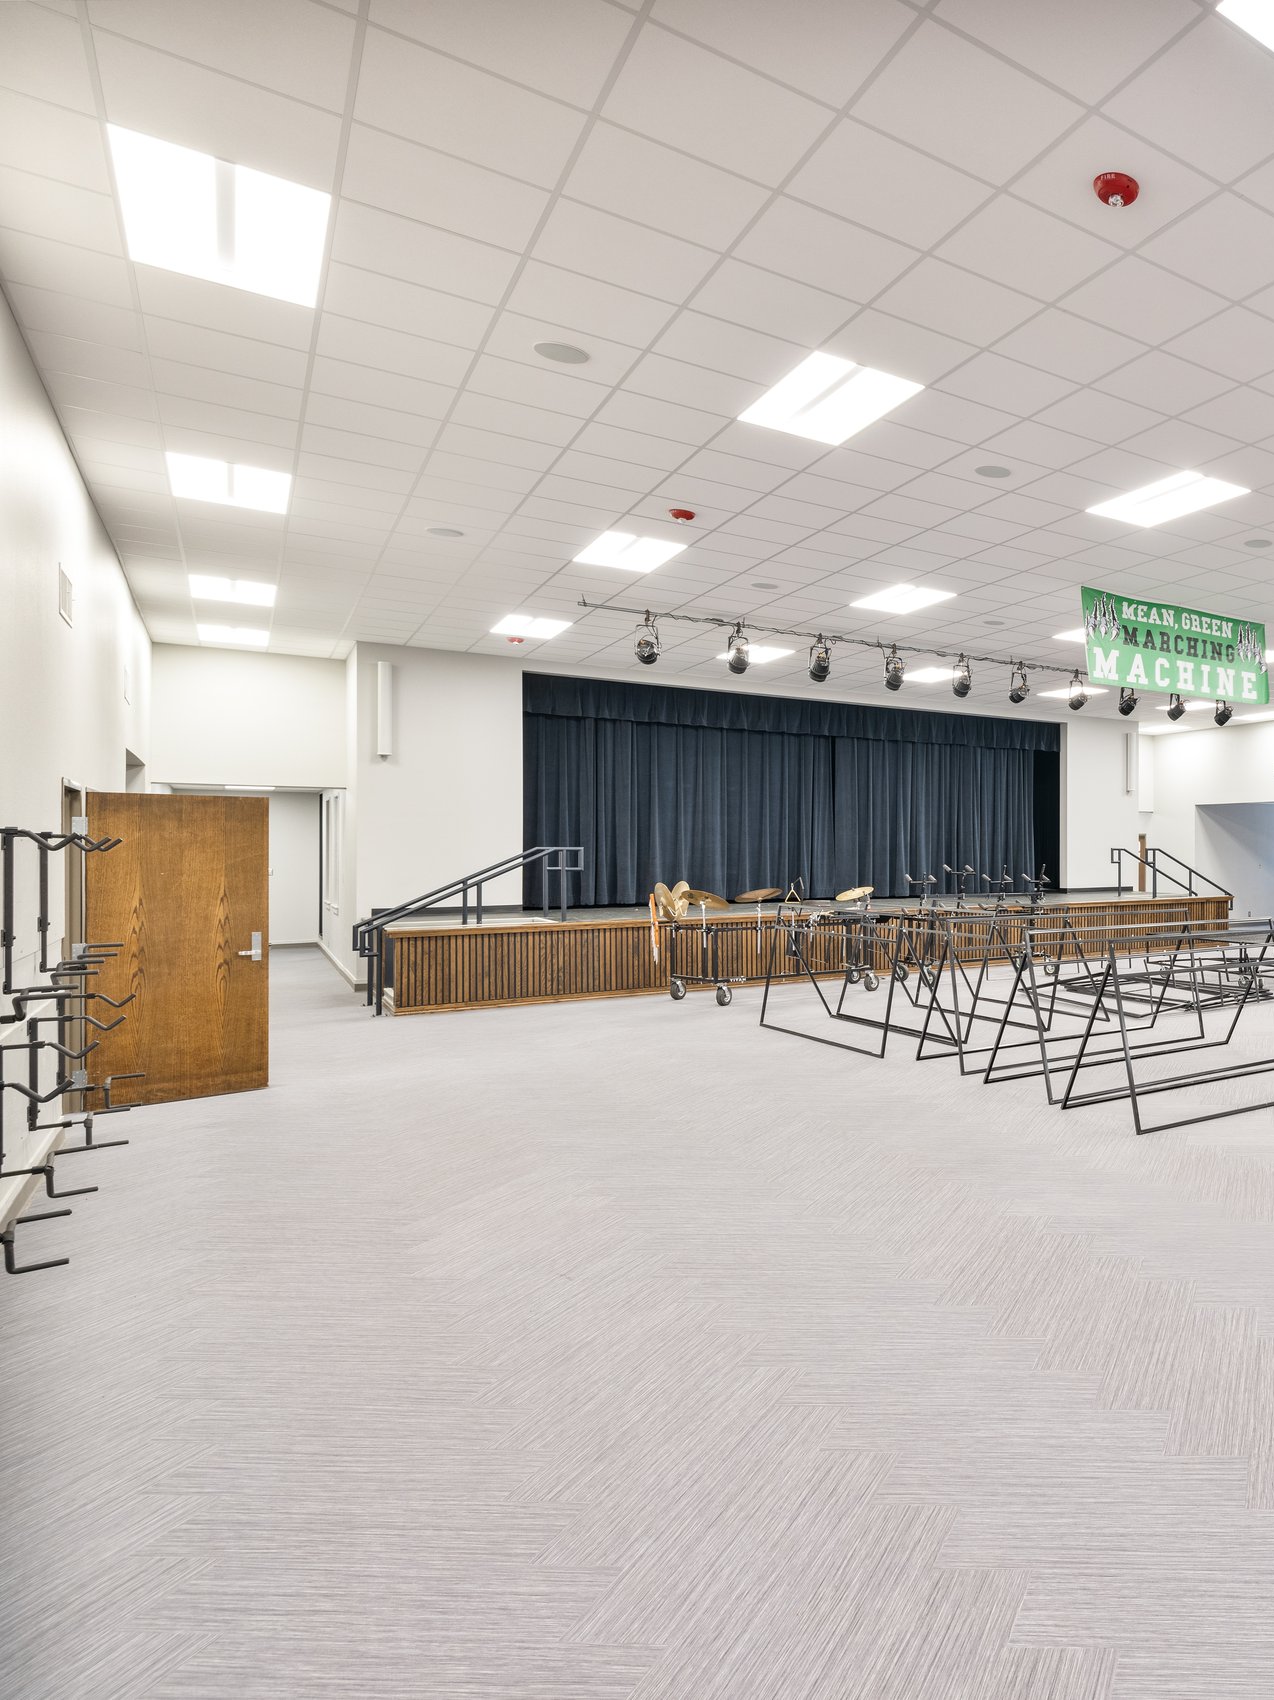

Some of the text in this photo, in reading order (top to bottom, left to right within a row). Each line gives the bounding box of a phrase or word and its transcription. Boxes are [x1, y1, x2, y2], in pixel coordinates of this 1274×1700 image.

[1121, 601, 1233, 639] MEAN, GREEN
[1121, 625, 1235, 664] MARCHING
[1093, 647, 1257, 699] MACHINE
